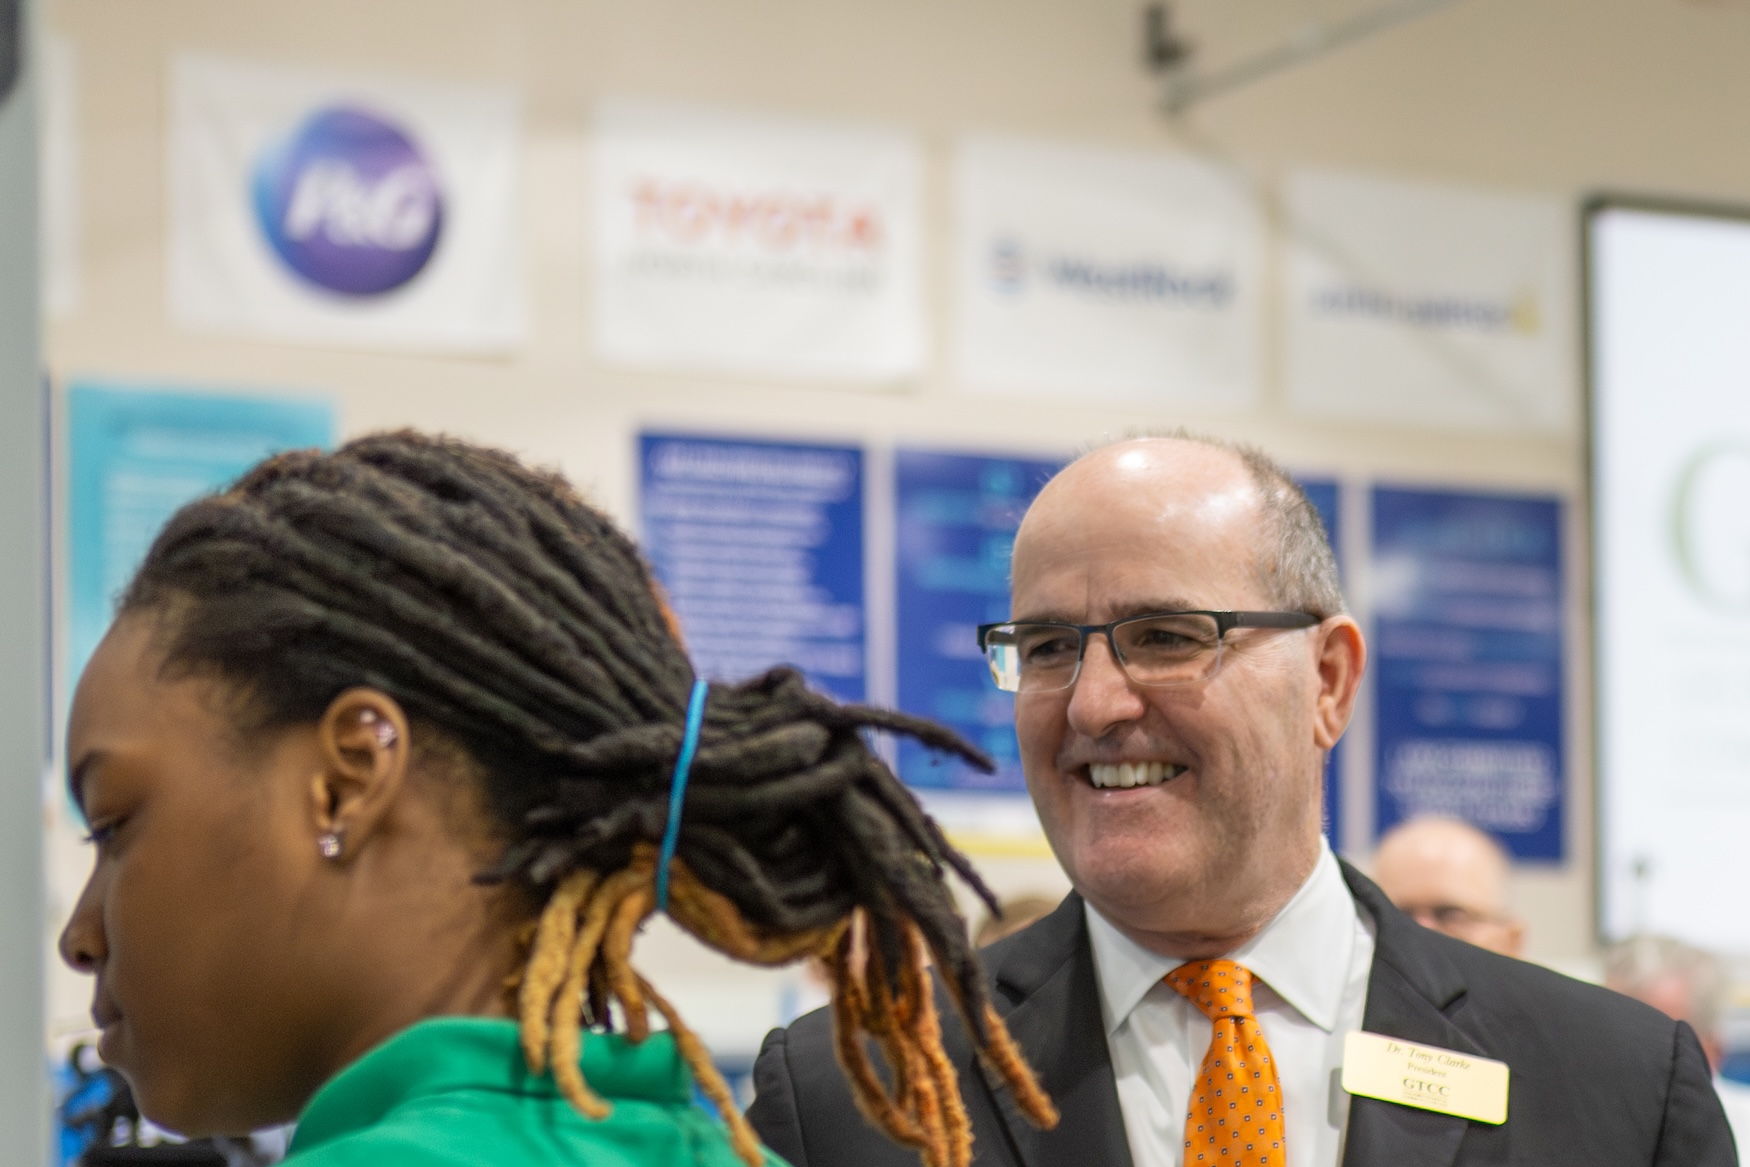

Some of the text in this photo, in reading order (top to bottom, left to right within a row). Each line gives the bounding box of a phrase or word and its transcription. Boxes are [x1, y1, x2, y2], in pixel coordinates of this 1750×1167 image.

[629, 174, 886, 252] TOYOTA
[1409, 1047, 1434, 1062] Tony
[1438, 1054, 1471, 1070] Clarke
[1407, 1061, 1447, 1078] President
[1402, 1078, 1450, 1097] GTCC
